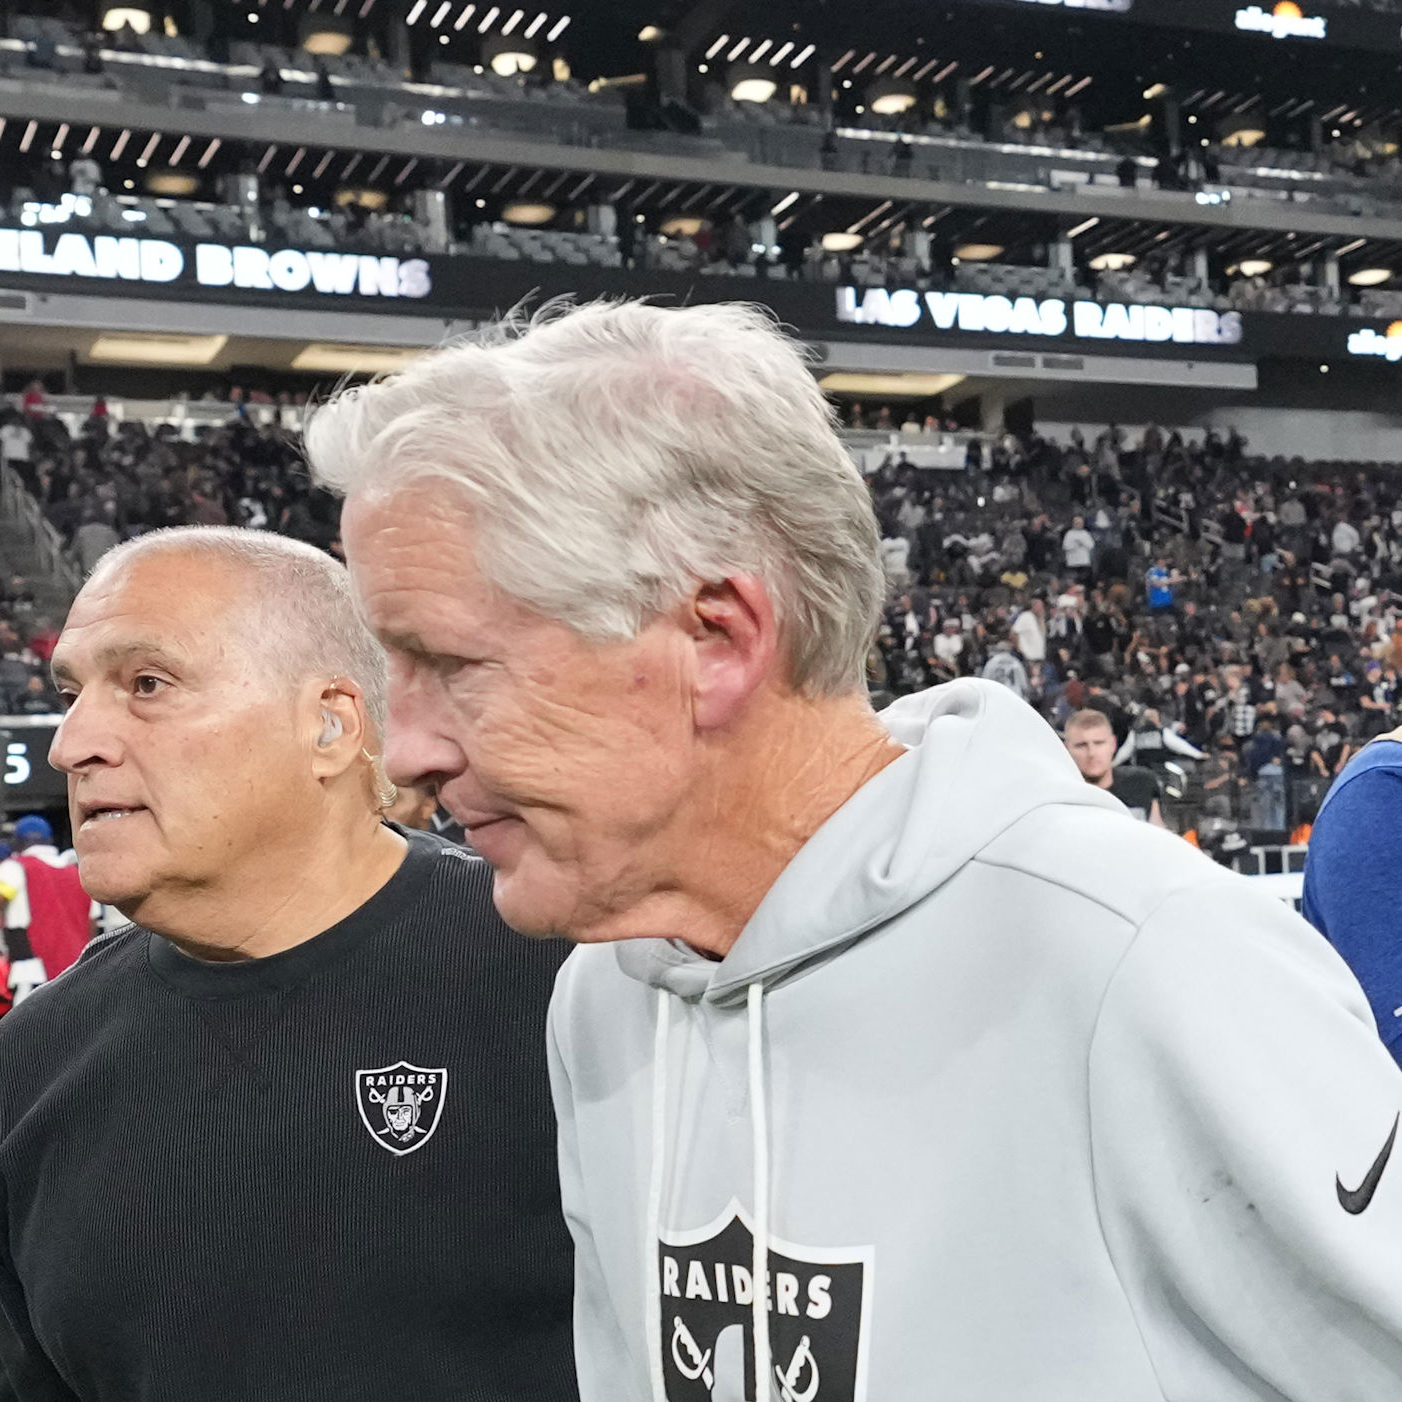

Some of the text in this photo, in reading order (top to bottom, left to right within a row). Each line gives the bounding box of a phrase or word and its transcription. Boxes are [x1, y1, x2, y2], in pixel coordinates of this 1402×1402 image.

[196, 243, 432, 298] BROWNS
[835, 286, 1243, 344] LAS VEGAS RAIDERS
[365, 1074, 437, 1086] RAIDERS
